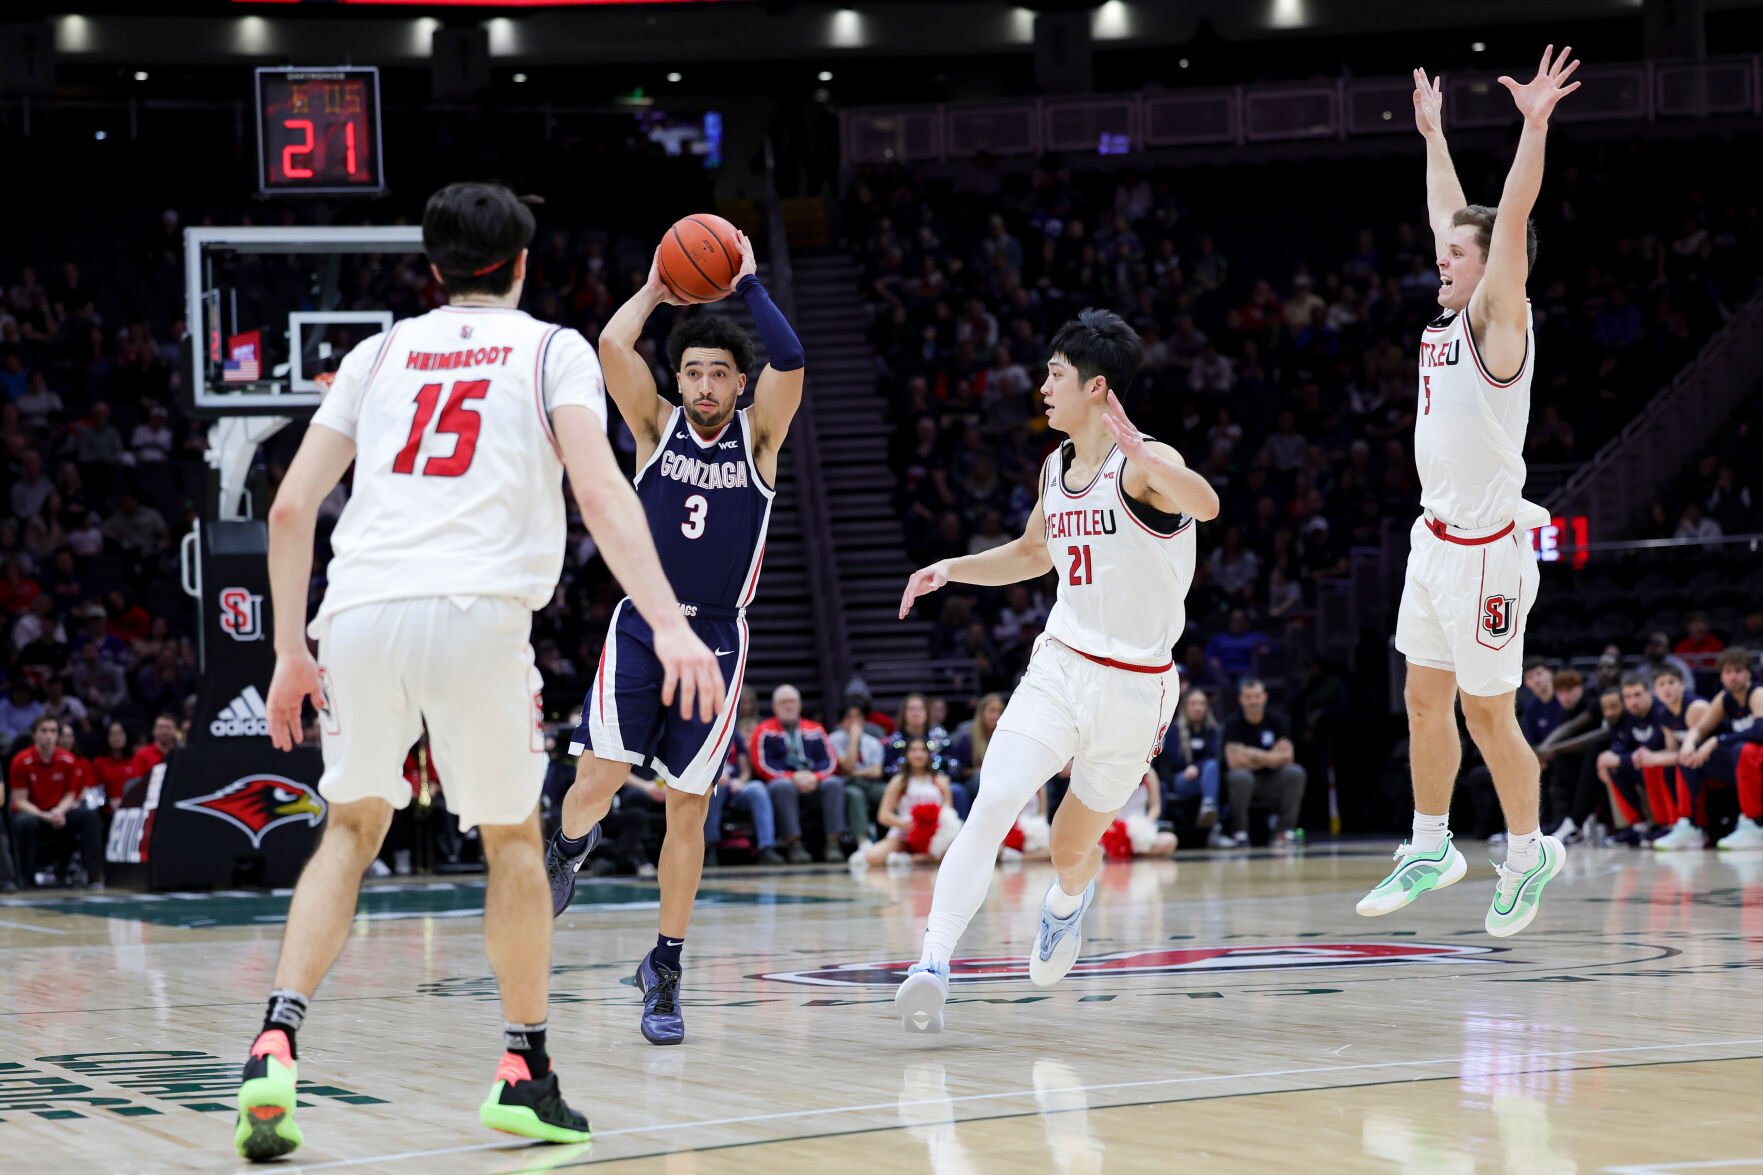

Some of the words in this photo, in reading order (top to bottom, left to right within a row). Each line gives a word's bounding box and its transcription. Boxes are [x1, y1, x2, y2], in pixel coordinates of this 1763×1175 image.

[282, 119, 357, 179] 21
[406, 346, 513, 370] HEIMBRODT
[392, 379, 491, 477] 15
[660, 450, 748, 490] GONZAGA
[681, 494, 708, 540] 3
[1067, 544, 1092, 586] 21
[678, 602, 698, 617] AGS
[209, 718, 271, 737] adida
